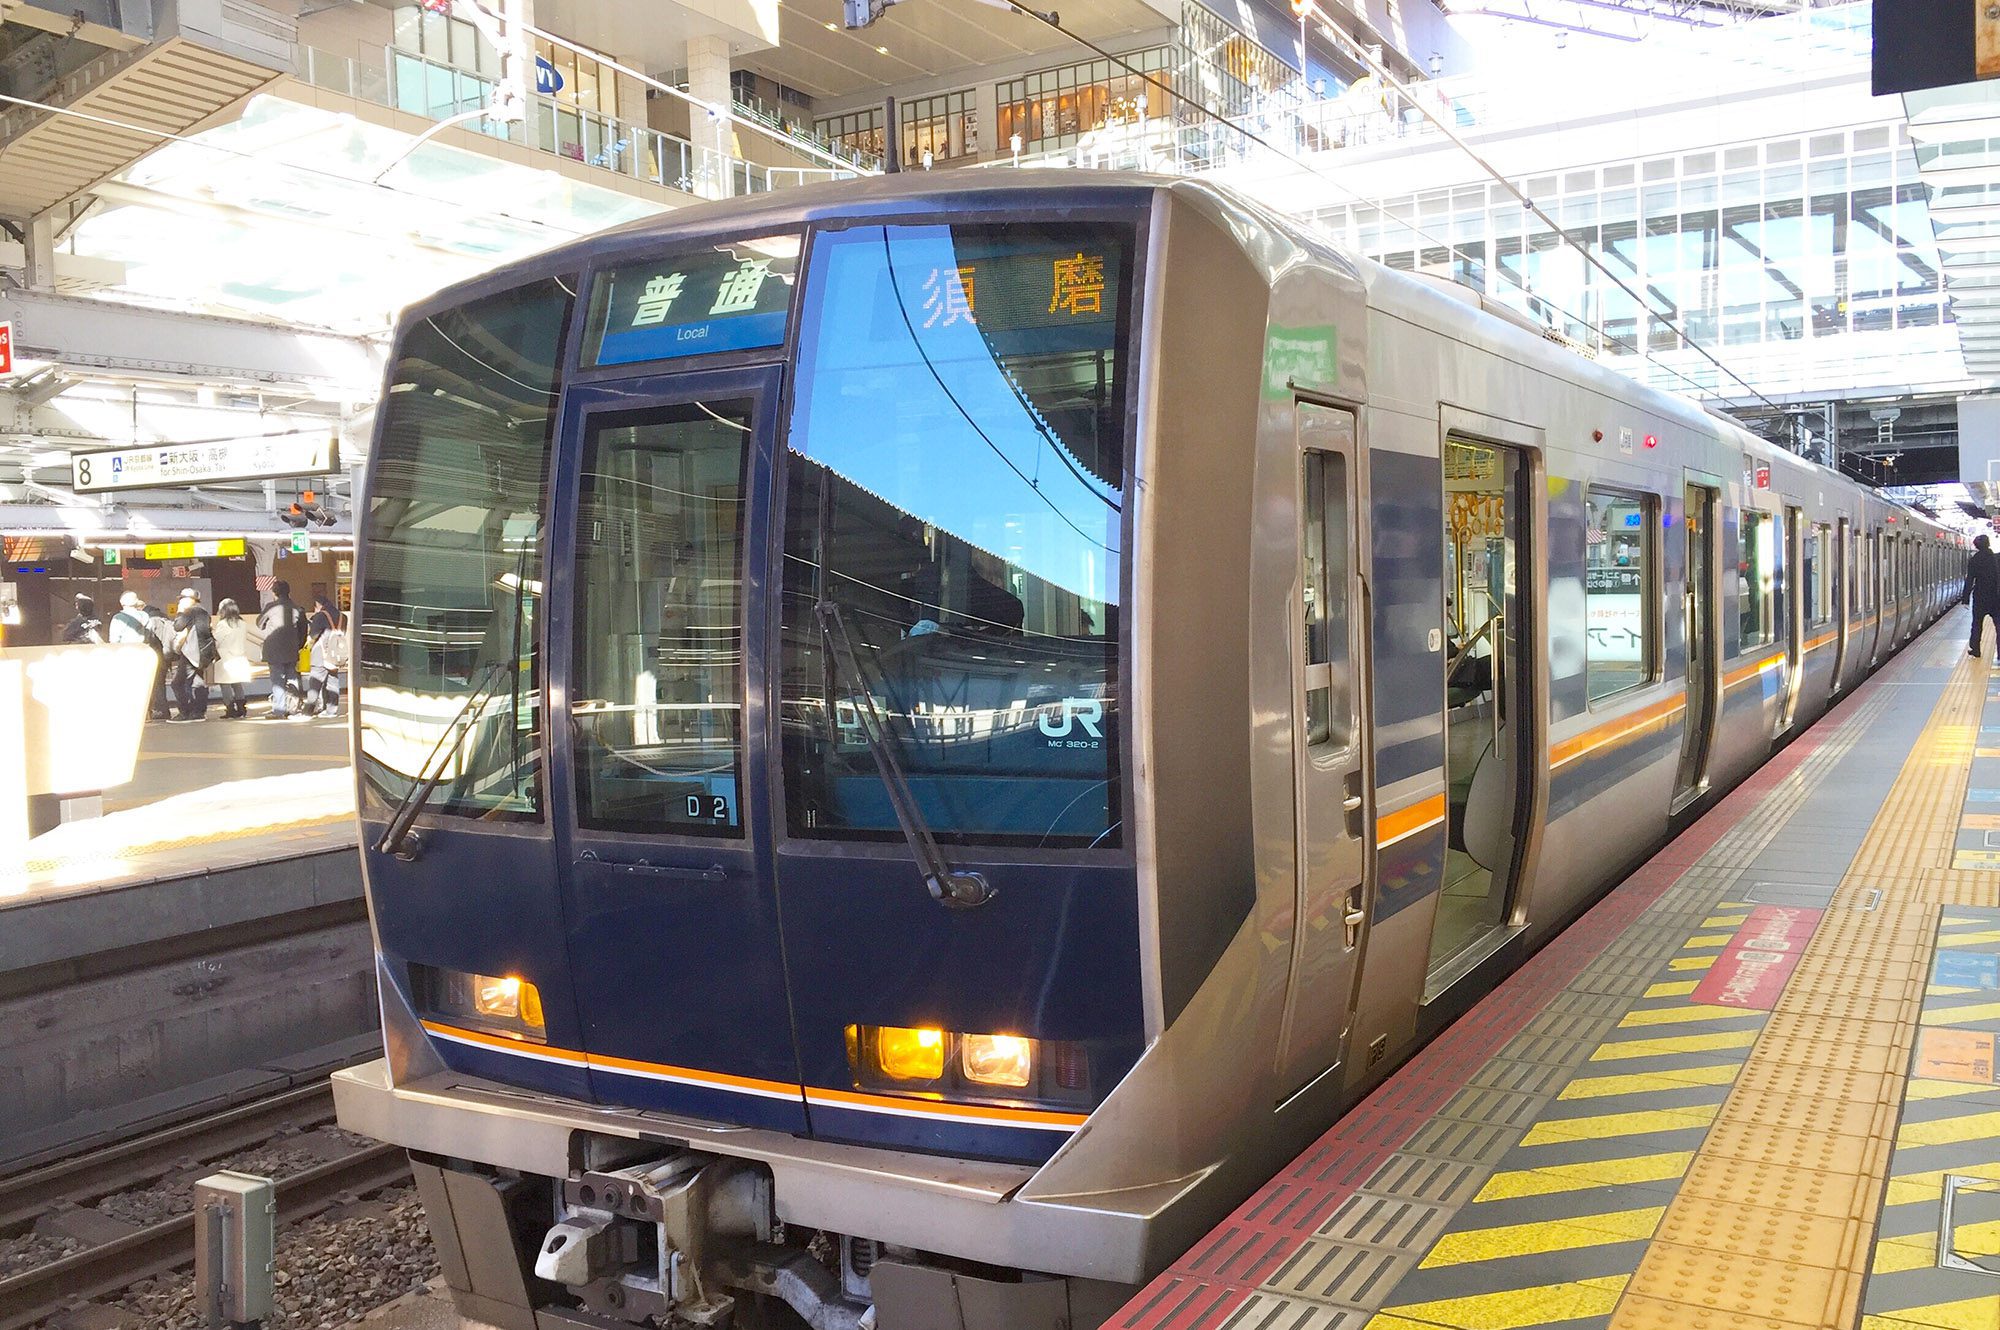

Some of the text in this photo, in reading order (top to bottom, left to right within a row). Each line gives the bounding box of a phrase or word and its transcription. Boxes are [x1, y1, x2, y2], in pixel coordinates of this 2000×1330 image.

[631, 258, 774, 326] 普通
[922, 251, 1105, 329] 須磨
[676, 325, 709, 341] Local
[79, 458, 92, 486] 8
[113, 457, 122, 472] A
[1039, 697, 1104, 738] JR
[1066, 740, 1099, 749] 320-2
[687, 795, 727, 819] D 2
